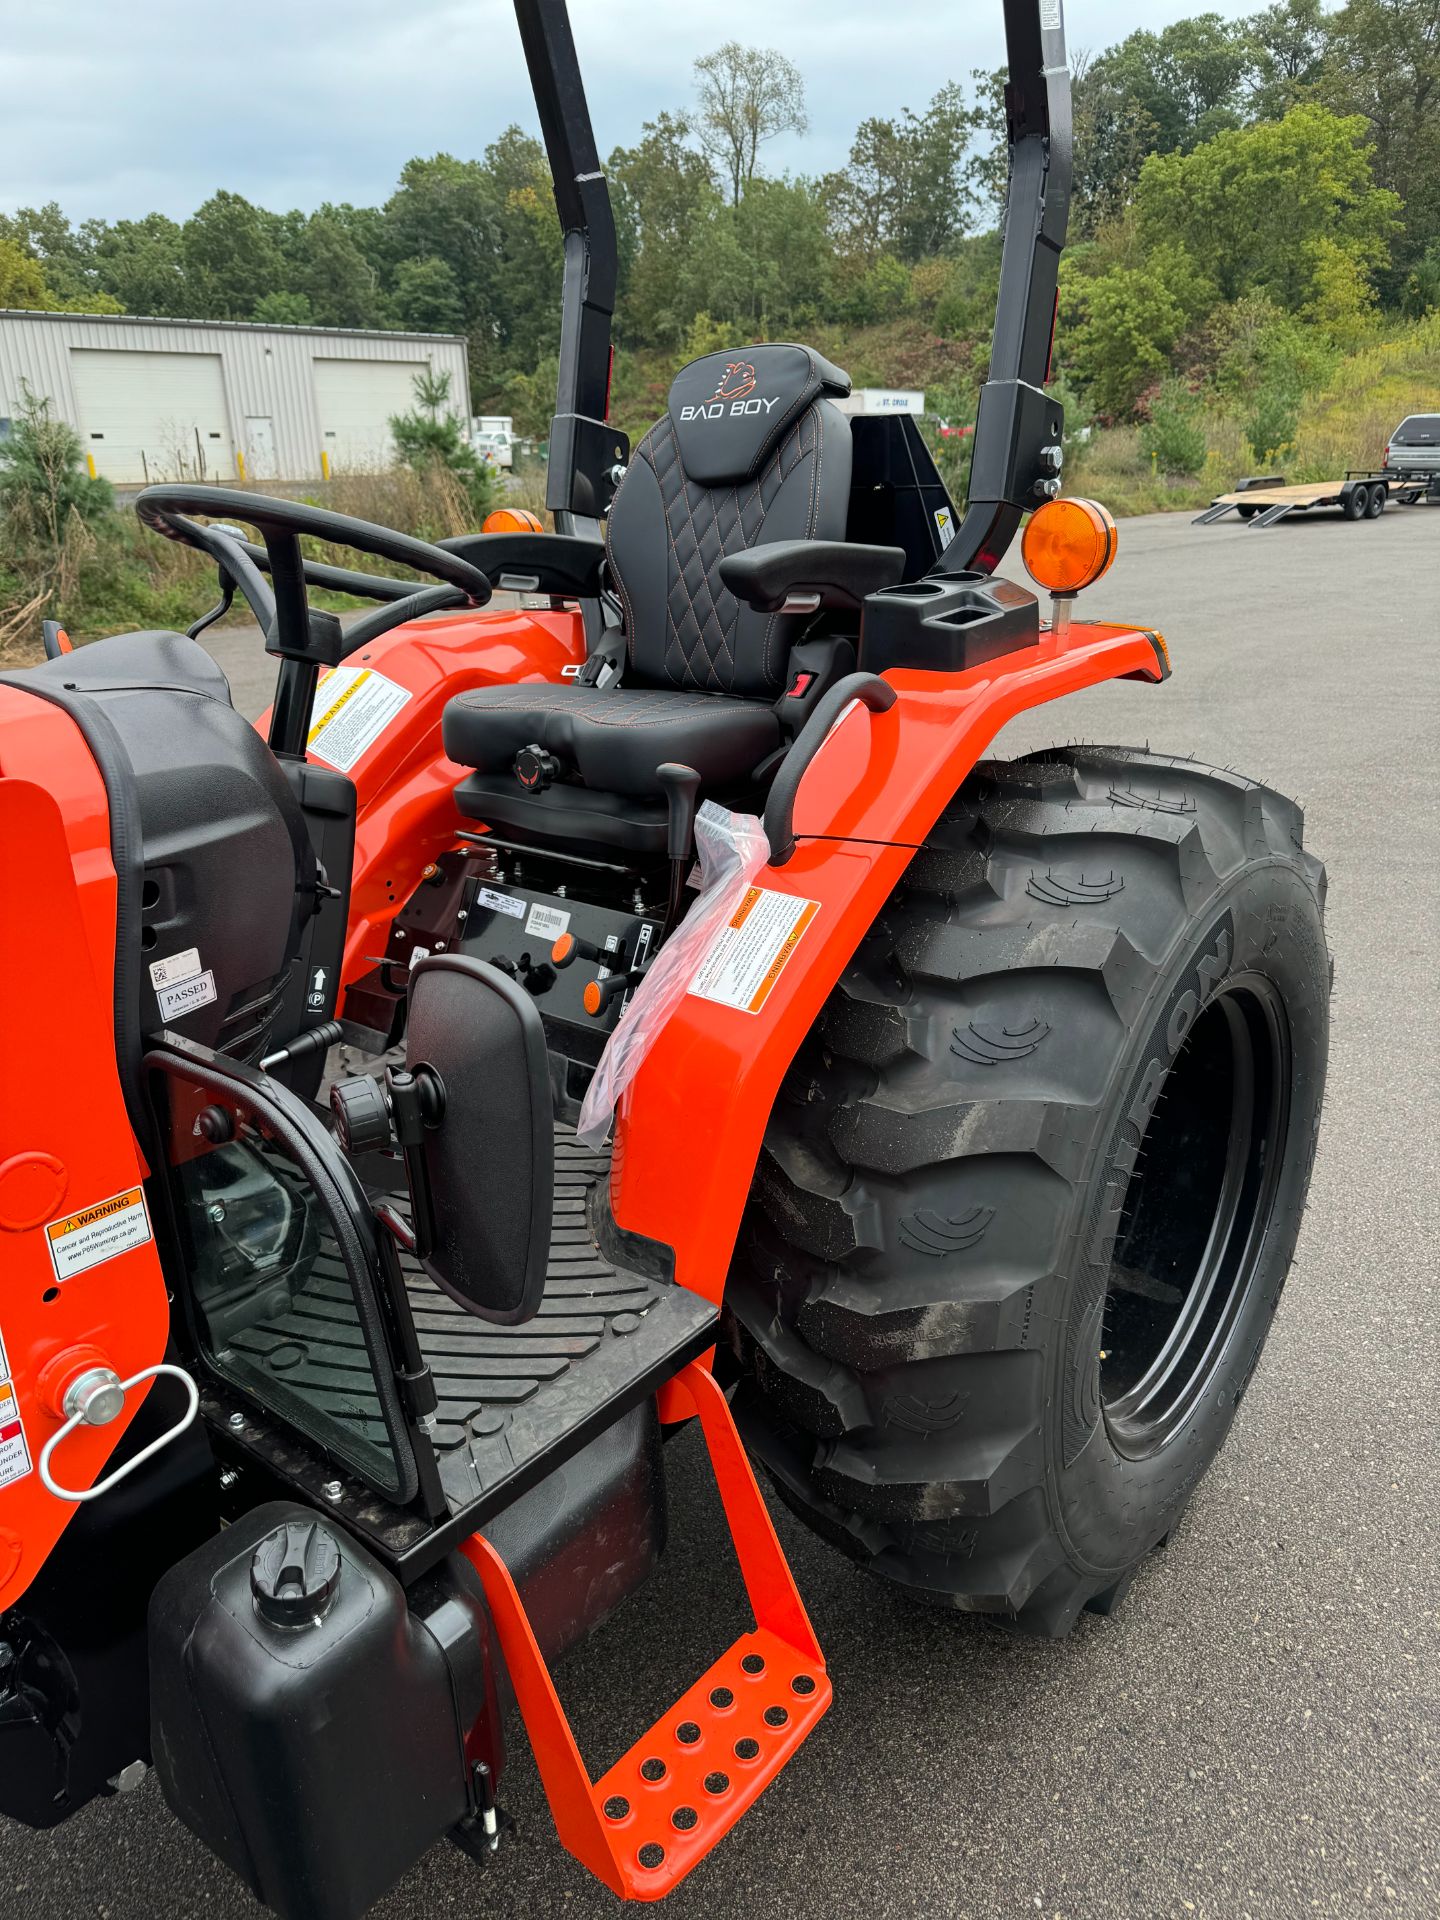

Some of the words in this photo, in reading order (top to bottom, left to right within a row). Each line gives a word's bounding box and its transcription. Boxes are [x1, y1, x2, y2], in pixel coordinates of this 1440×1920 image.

[680, 403, 724, 420] BAD
[730, 397, 780, 417] BOY
[323, 683, 360, 721] CAUTION
[731, 896, 753, 927] WARNING
[768, 941, 794, 979] WARNING
[167, 982, 208, 1006] PASSED
[77, 1197, 130, 1226] WARNING
[56, 1239, 77, 1254] Cancer
[78, 1233, 90, 1244] and
[90, 1217, 127, 1240] Reproductive
[127, 1210, 143, 1223] Harm
